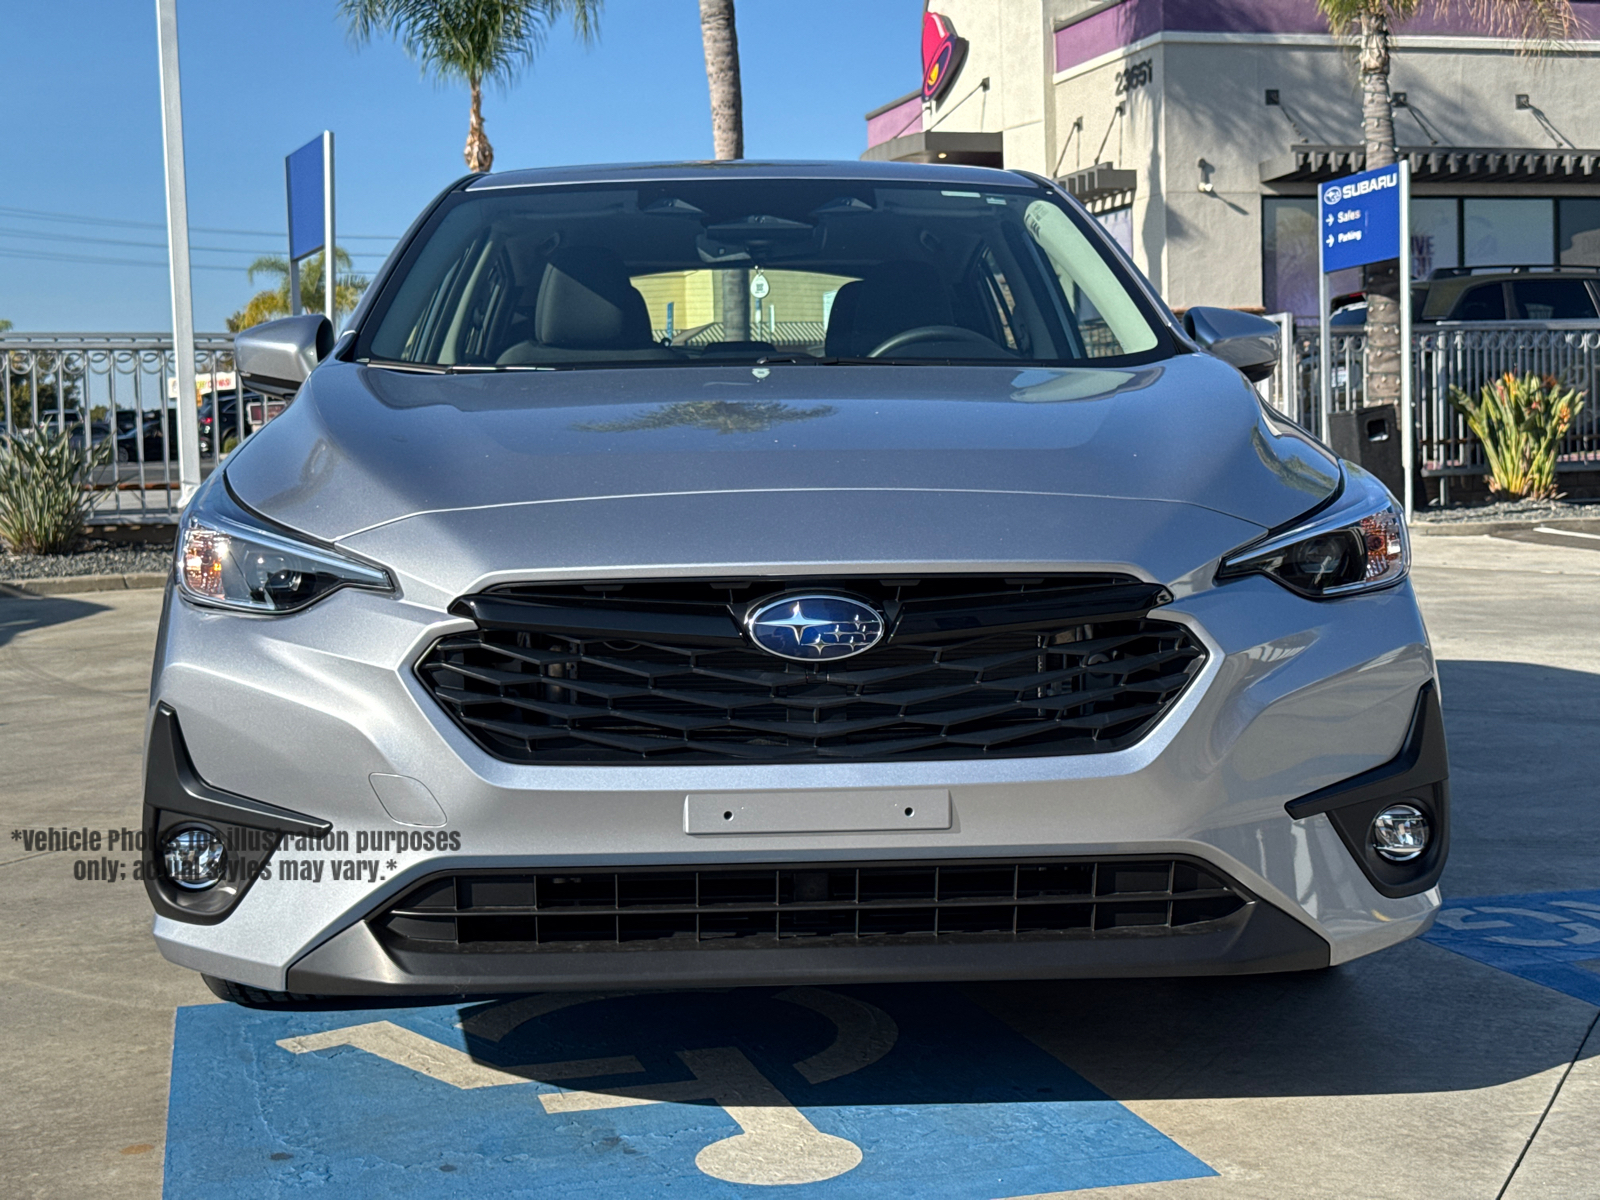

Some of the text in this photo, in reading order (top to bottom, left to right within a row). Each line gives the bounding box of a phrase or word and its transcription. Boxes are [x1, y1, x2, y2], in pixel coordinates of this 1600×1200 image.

[1342, 173, 1397, 198] SUBARU
[1337, 209, 1361, 223] Sales
[1338, 230, 1362, 243] Parking
